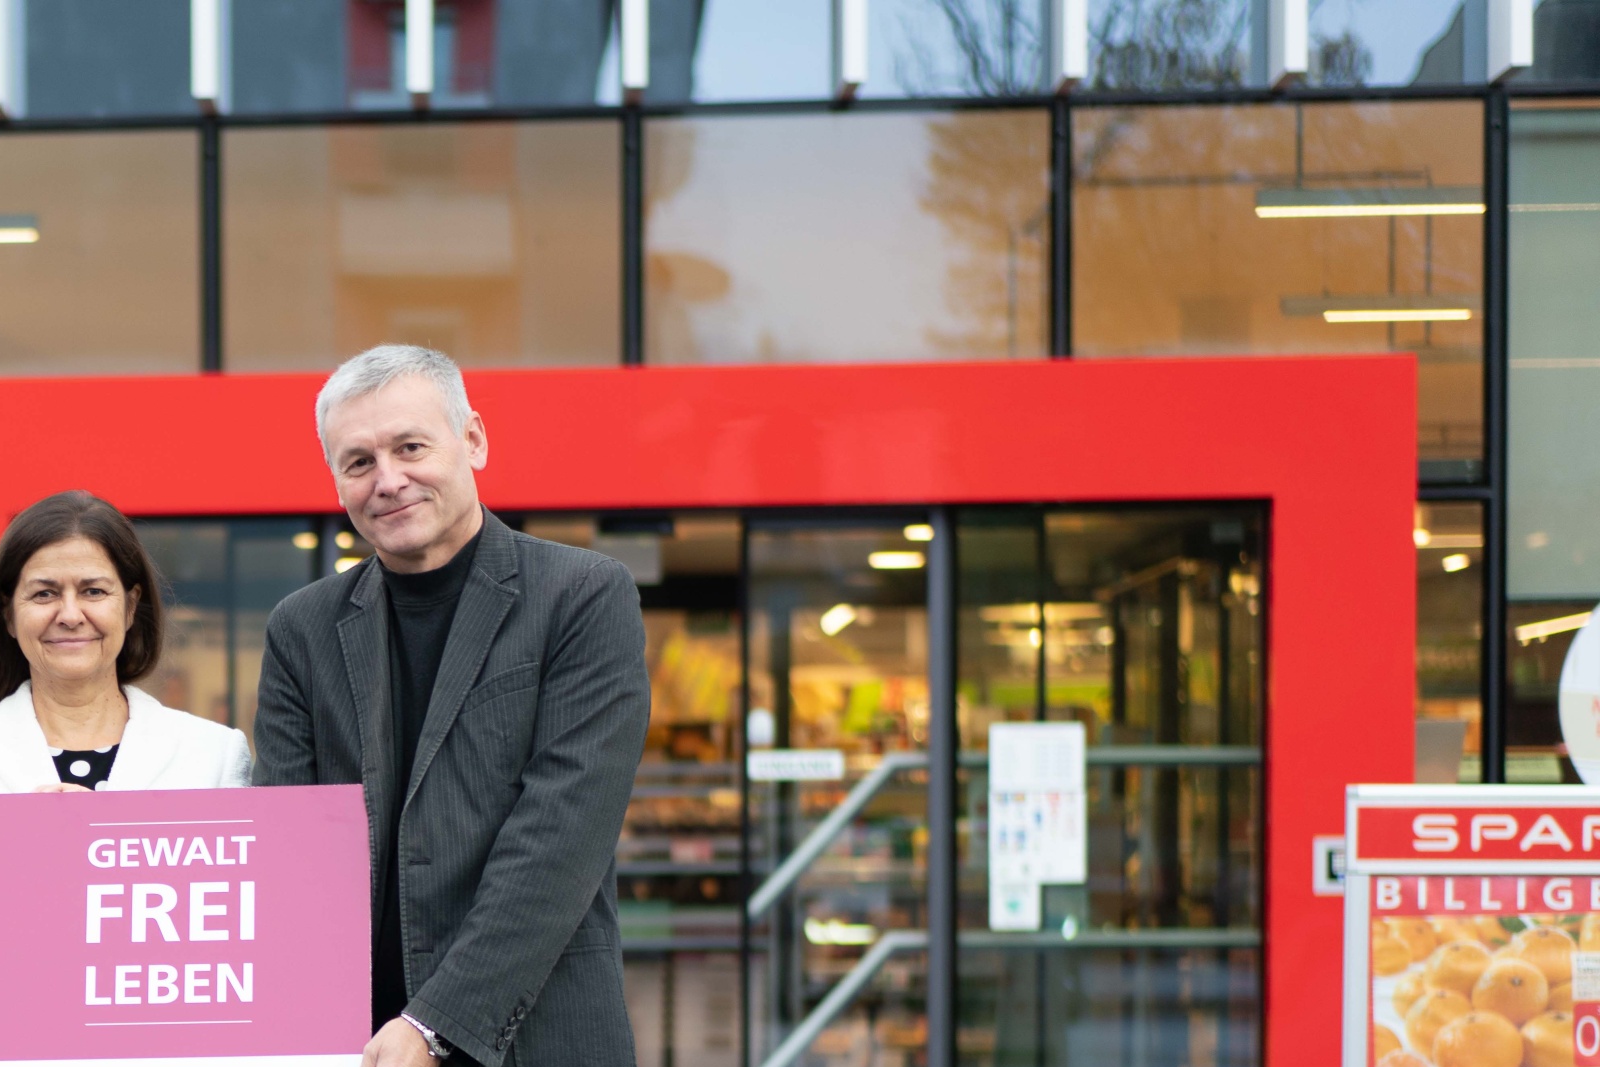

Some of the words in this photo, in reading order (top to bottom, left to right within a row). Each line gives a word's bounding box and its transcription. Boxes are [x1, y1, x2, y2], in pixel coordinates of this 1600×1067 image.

[87, 835, 256, 868] GEWALT
[86, 881, 255, 943] FREI
[85, 962, 254, 1005] LEBEN
